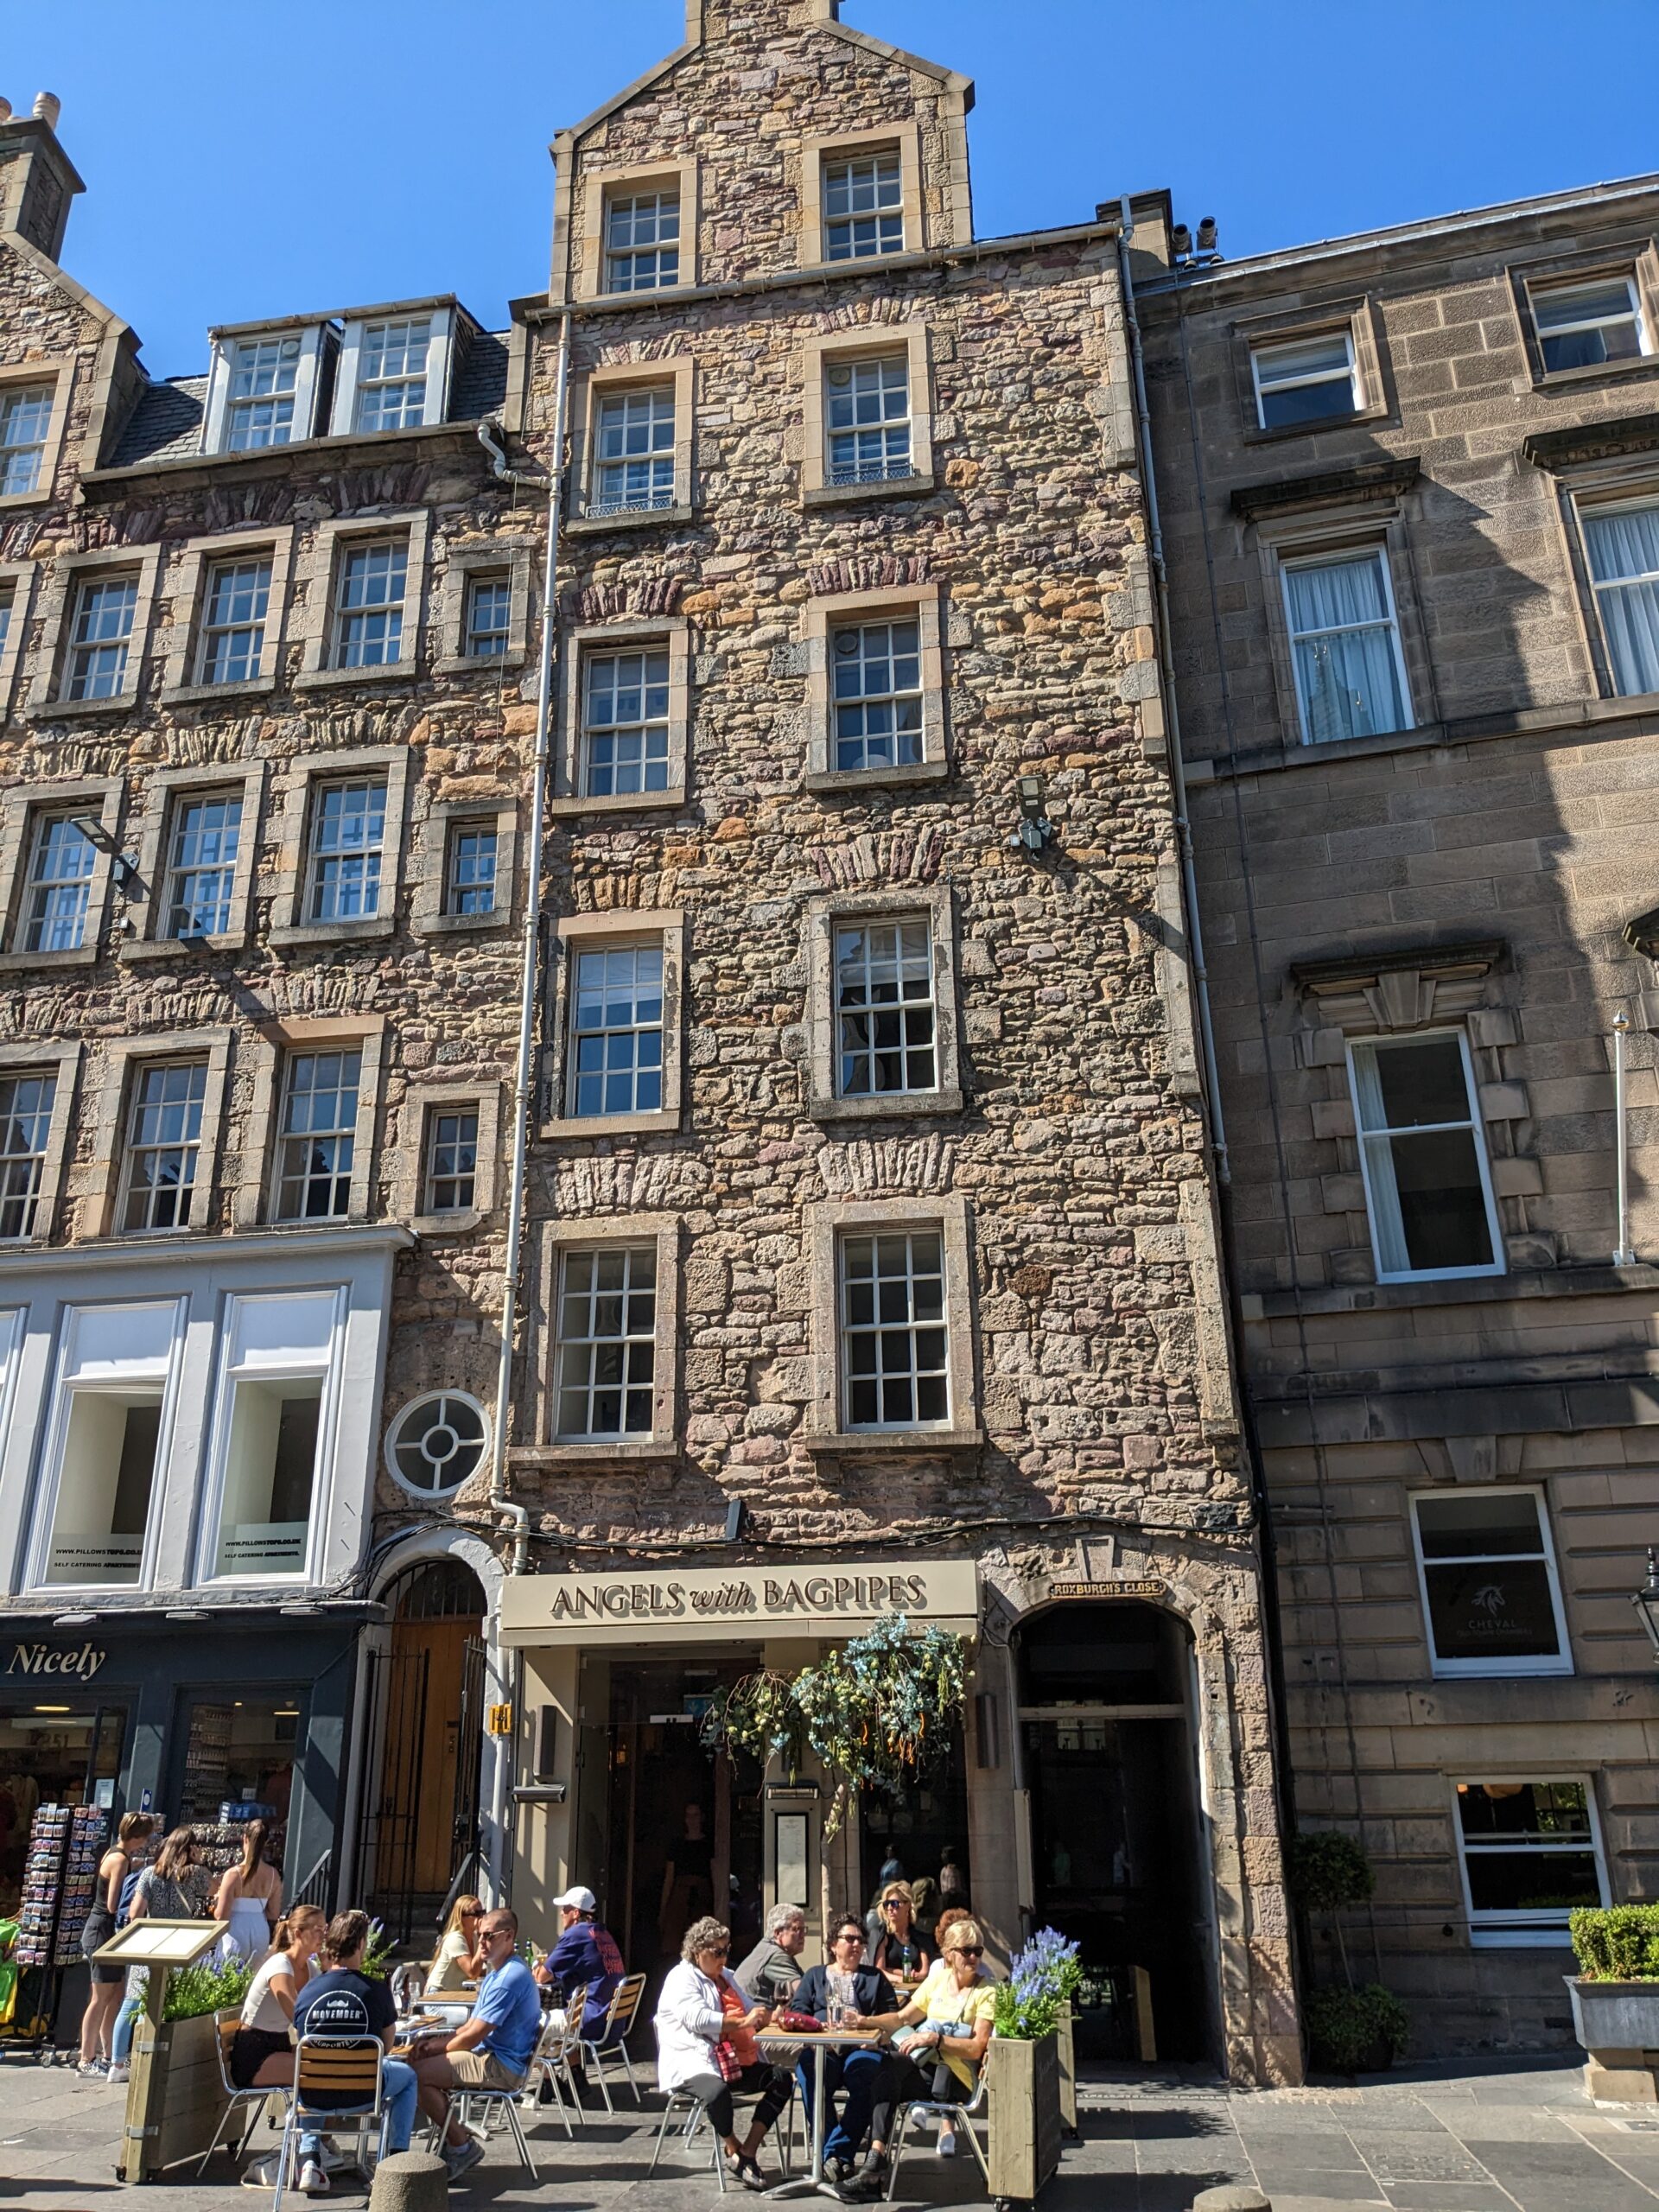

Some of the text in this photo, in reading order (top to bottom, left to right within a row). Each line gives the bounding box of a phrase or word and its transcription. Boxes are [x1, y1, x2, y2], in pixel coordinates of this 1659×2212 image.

[551, 1574, 923, 1614] ANGELS with BAGPIPES
[1054, 1580, 1160, 1595] ROXBURGH'S CLOSE
[1468, 1618, 1517, 1630] CHEVAL
[4, 1642, 106, 1681] Nicely
[312, 2009, 360, 2019] MOVEMBER
